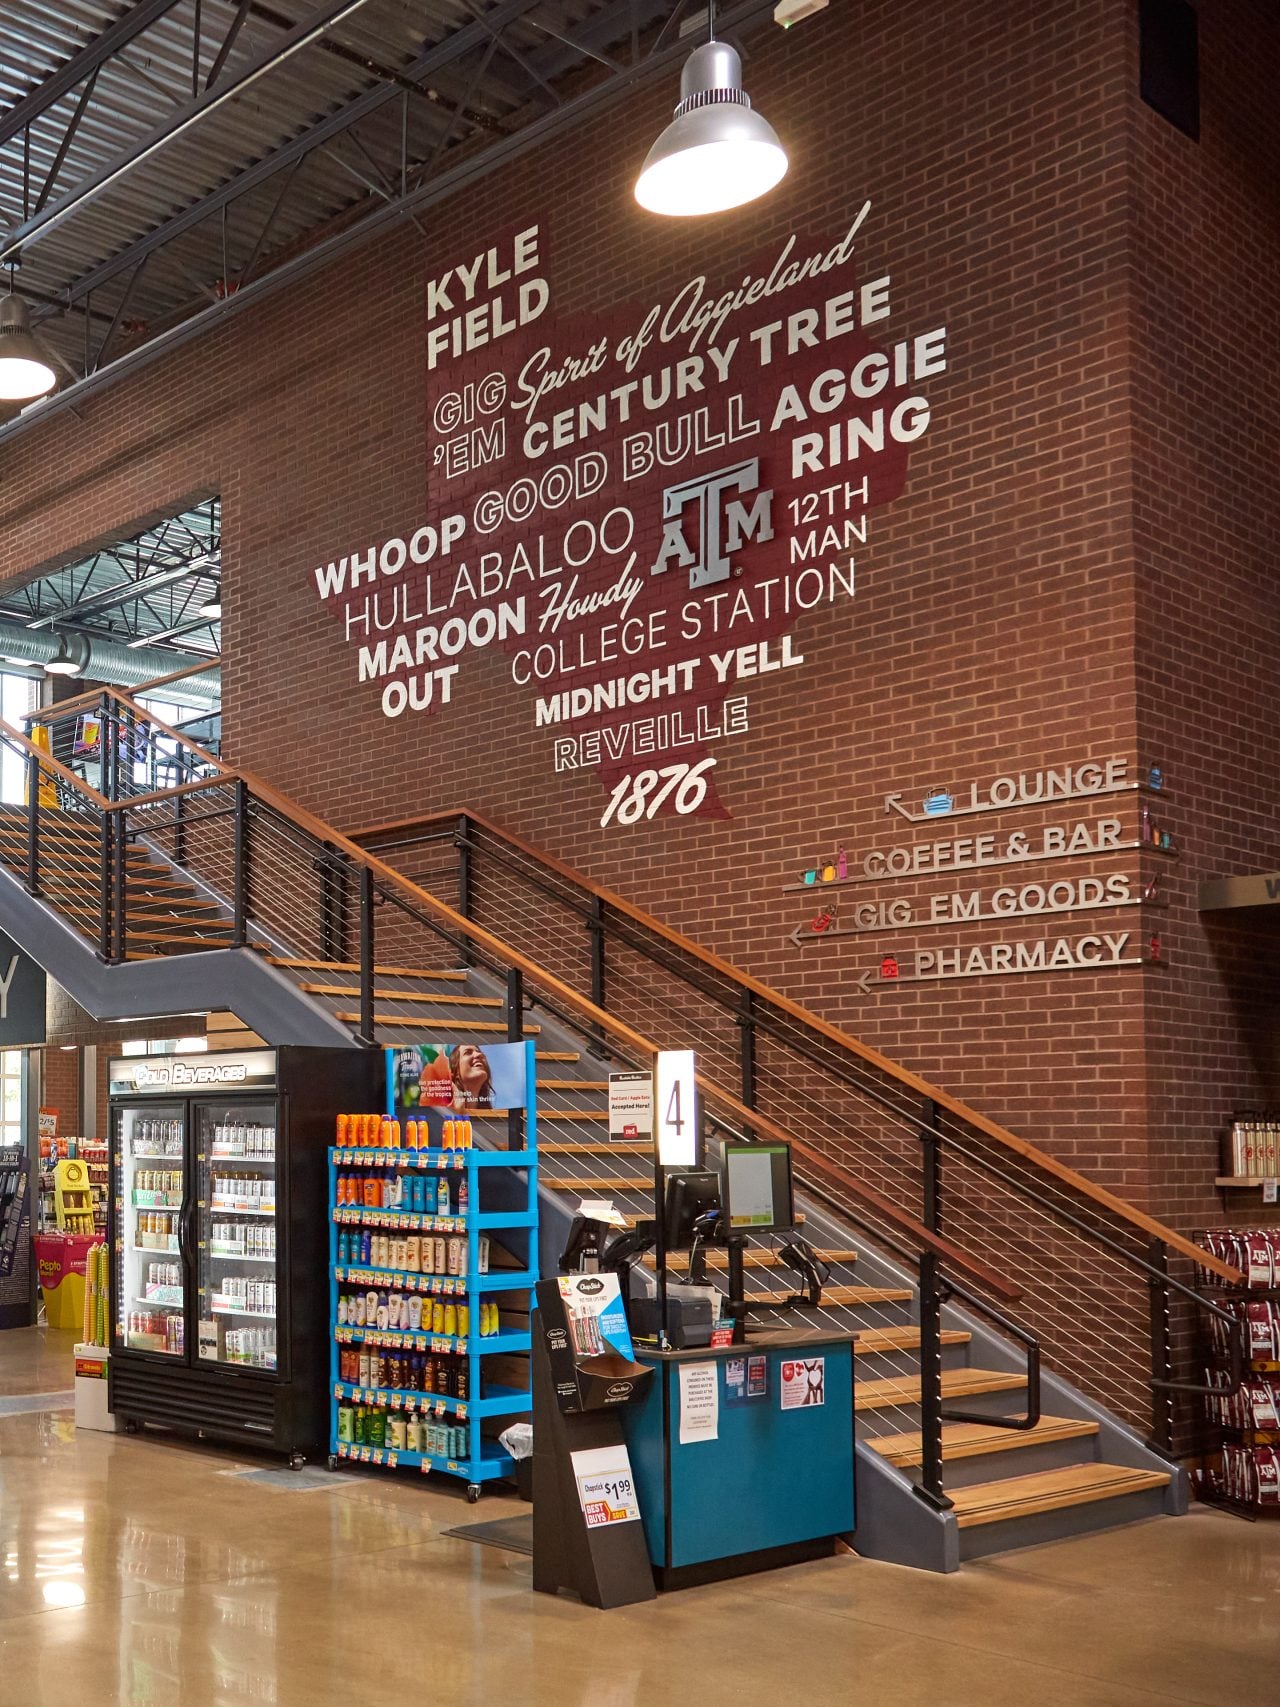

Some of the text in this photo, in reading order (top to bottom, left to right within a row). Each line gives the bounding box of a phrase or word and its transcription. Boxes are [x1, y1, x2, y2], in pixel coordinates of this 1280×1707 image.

[428, 225, 538, 321] KYLE
[428, 278, 550, 369] FIELD
[511, 201, 872, 423] Spirit of Aggieland
[433, 371, 506, 433] GIG
[523, 276, 891, 459] CENTURY TREE
[770, 327, 947, 432] AGGIE
[474, 394, 761, 534] GOOD BULL
[792, 397, 931, 479] RING
[788, 477, 869, 528] 12TH
[314, 515, 466, 600] WHOOP
[344, 507, 634, 641] HULLABALOO
[789, 515, 867, 564] MAN
[512, 557, 856, 685] COLLEGE STATION
[538, 552, 644, 634] Howdy
[358, 598, 525, 682] MAROON
[382, 664, 458, 717] OUT
[536, 635, 803, 727] MIDNIGHT YELL
[554, 697, 749, 772] REVEILLE
[600, 758, 718, 828] 1876
[970, 759, 1128, 810] LOUNGE
[863, 819, 1122, 879] COFFEE & BAR
[854, 874, 1130, 929] GIG EM GOODS
[915, 933, 1131, 977] PHARMACY
[172, 1063, 247, 1084] BEVERAGES
[666, 1080, 684, 1136] 4
[38, 1259, 61, 1272] Pepto
[586, 1503, 604, 1514] BEST
[588, 1513, 607, 1524] BUYS
